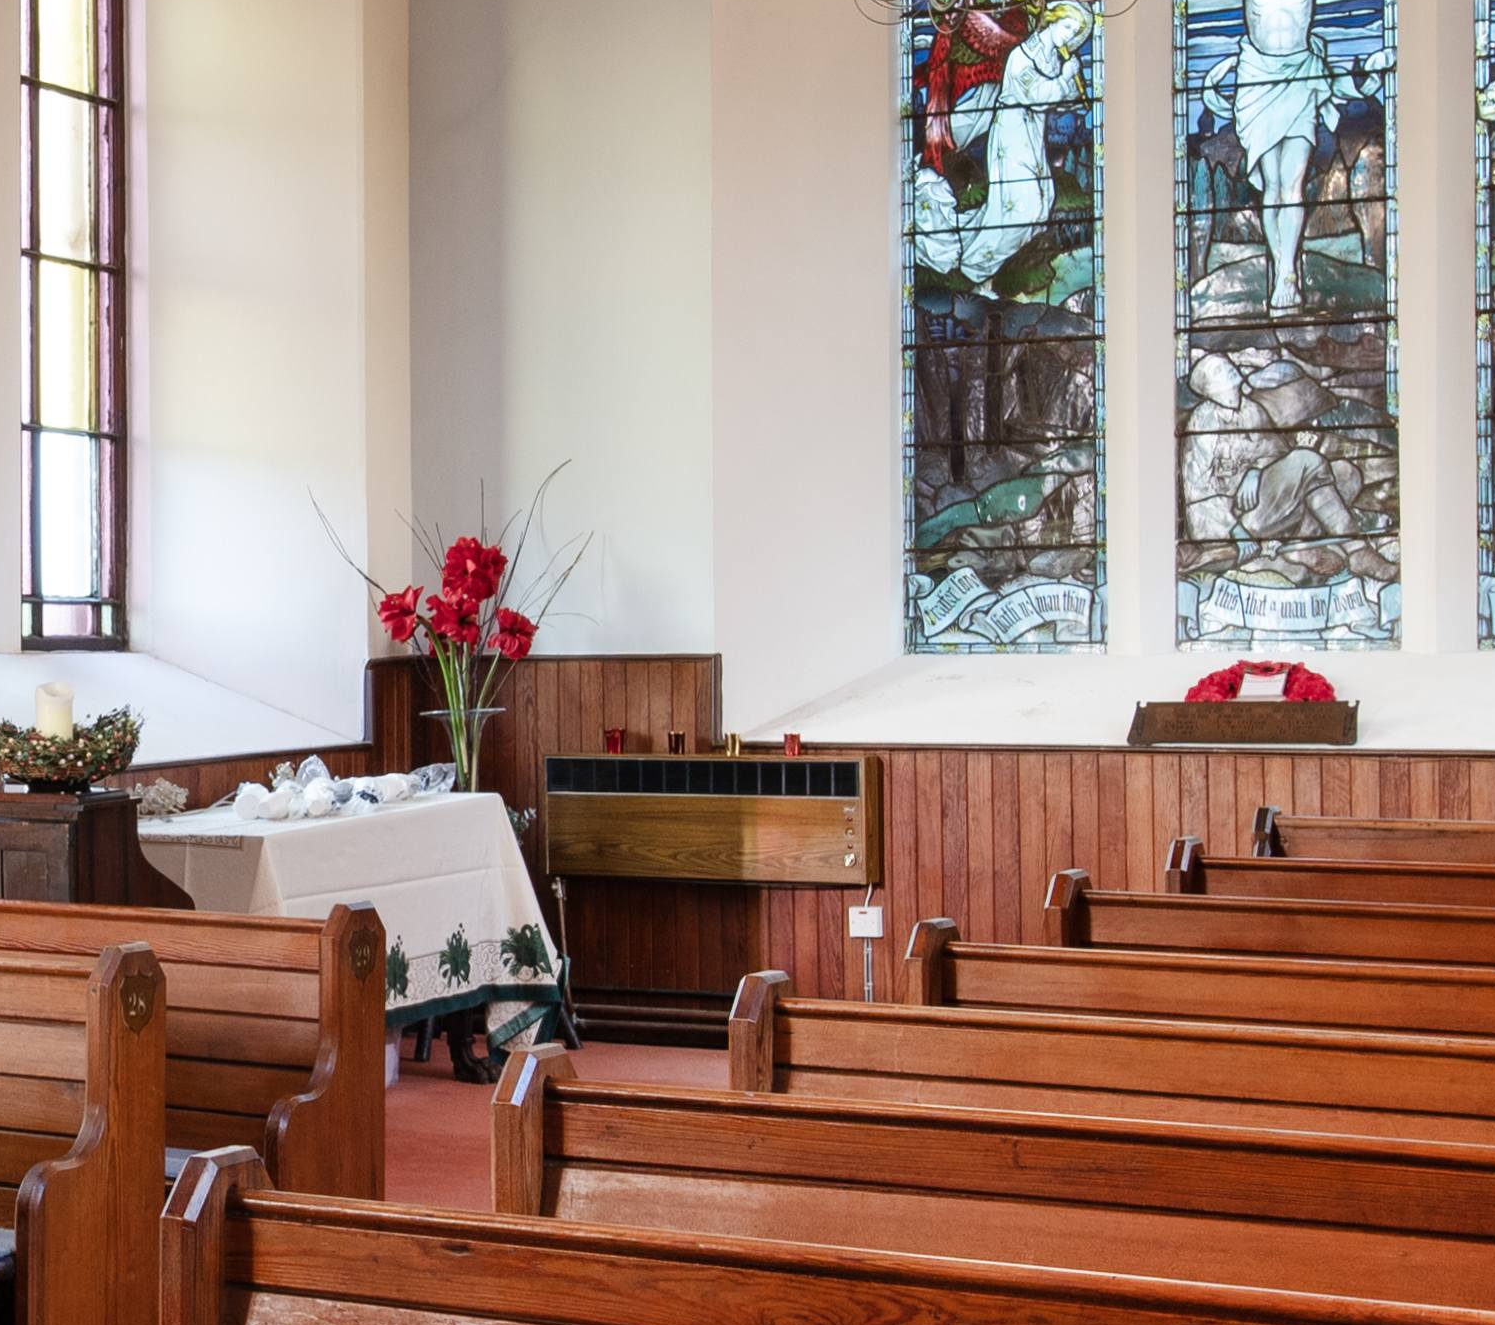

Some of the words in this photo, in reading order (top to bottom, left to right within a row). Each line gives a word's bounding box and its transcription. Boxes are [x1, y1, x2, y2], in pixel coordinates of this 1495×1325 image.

[991, 600, 1020, 634] hath
[1035, 592, 1060, 614] man
[1063, 589, 1086, 615] than
[1244, 590, 1267, 616] that
[1280, 599, 1307, 619] man
[128, 992, 147, 1016] 28
